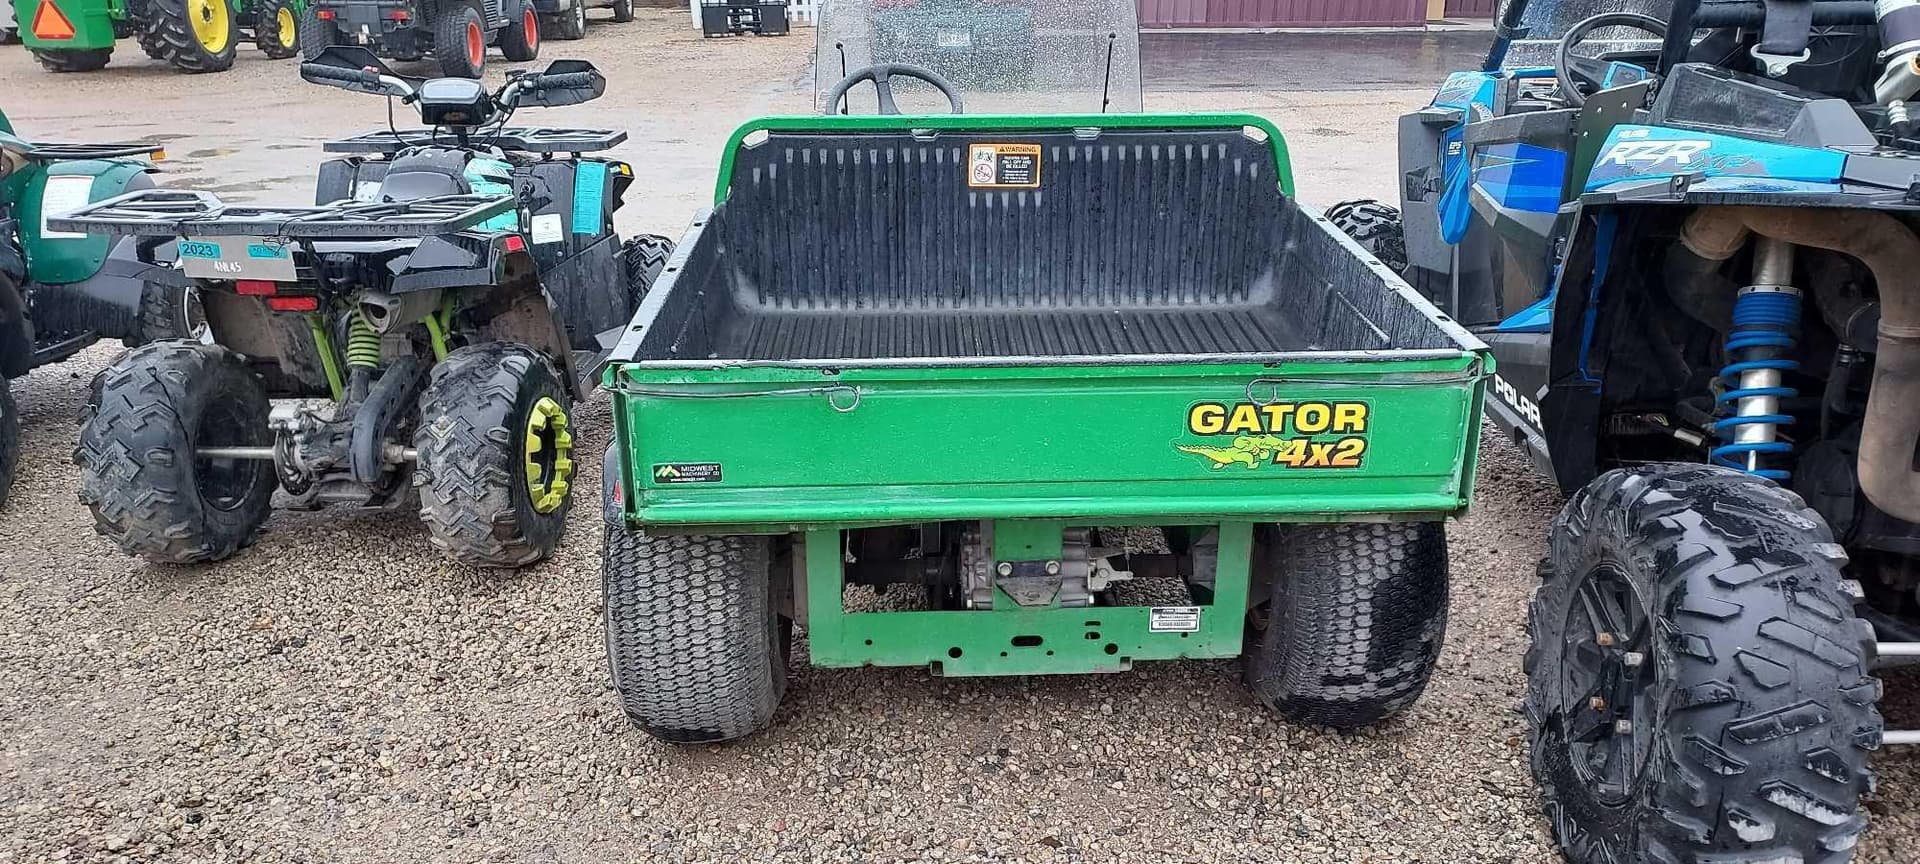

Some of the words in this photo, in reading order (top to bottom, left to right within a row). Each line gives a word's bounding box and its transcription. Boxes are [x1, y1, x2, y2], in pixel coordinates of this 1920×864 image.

[1596, 140, 1712, 168] RZR
[182, 243, 214, 257] 2023
[1189, 402, 1368, 435] GATOR
[1273, 437, 1366, 469] 4x2
